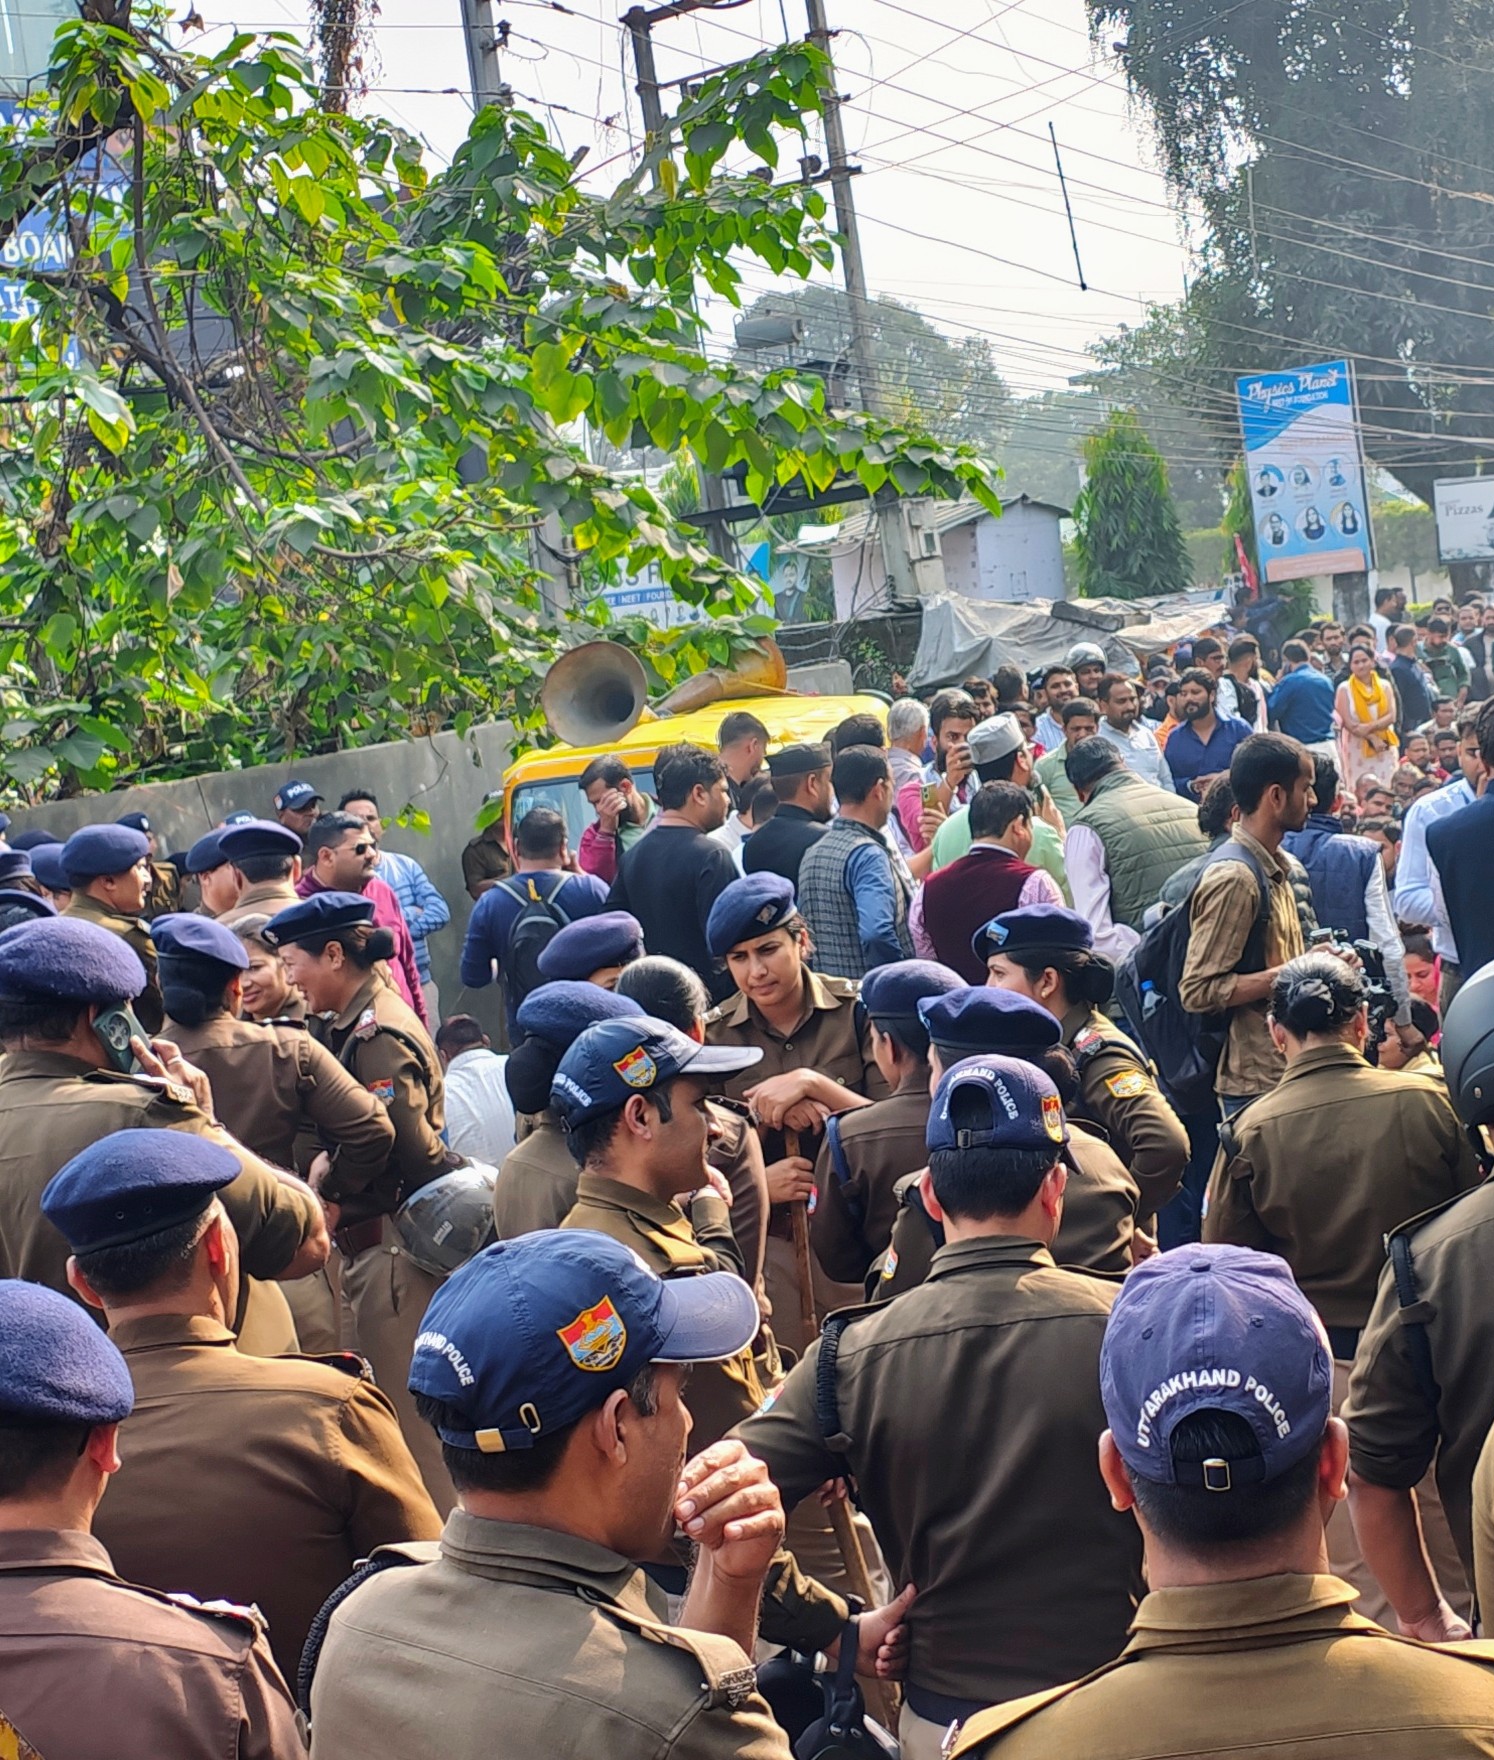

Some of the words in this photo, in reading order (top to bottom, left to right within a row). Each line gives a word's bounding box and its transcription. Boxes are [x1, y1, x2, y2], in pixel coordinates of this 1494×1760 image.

[1247, 381, 1295, 414] Physics
[1445, 504, 1484, 517] Pizzas
[993, 1078, 1020, 1121] POLICE
[441, 1342, 475, 1387] POLICE
[1136, 1368, 1242, 1449] UTTARAKHAND
[1244, 1375, 1292, 1440] POLICE
